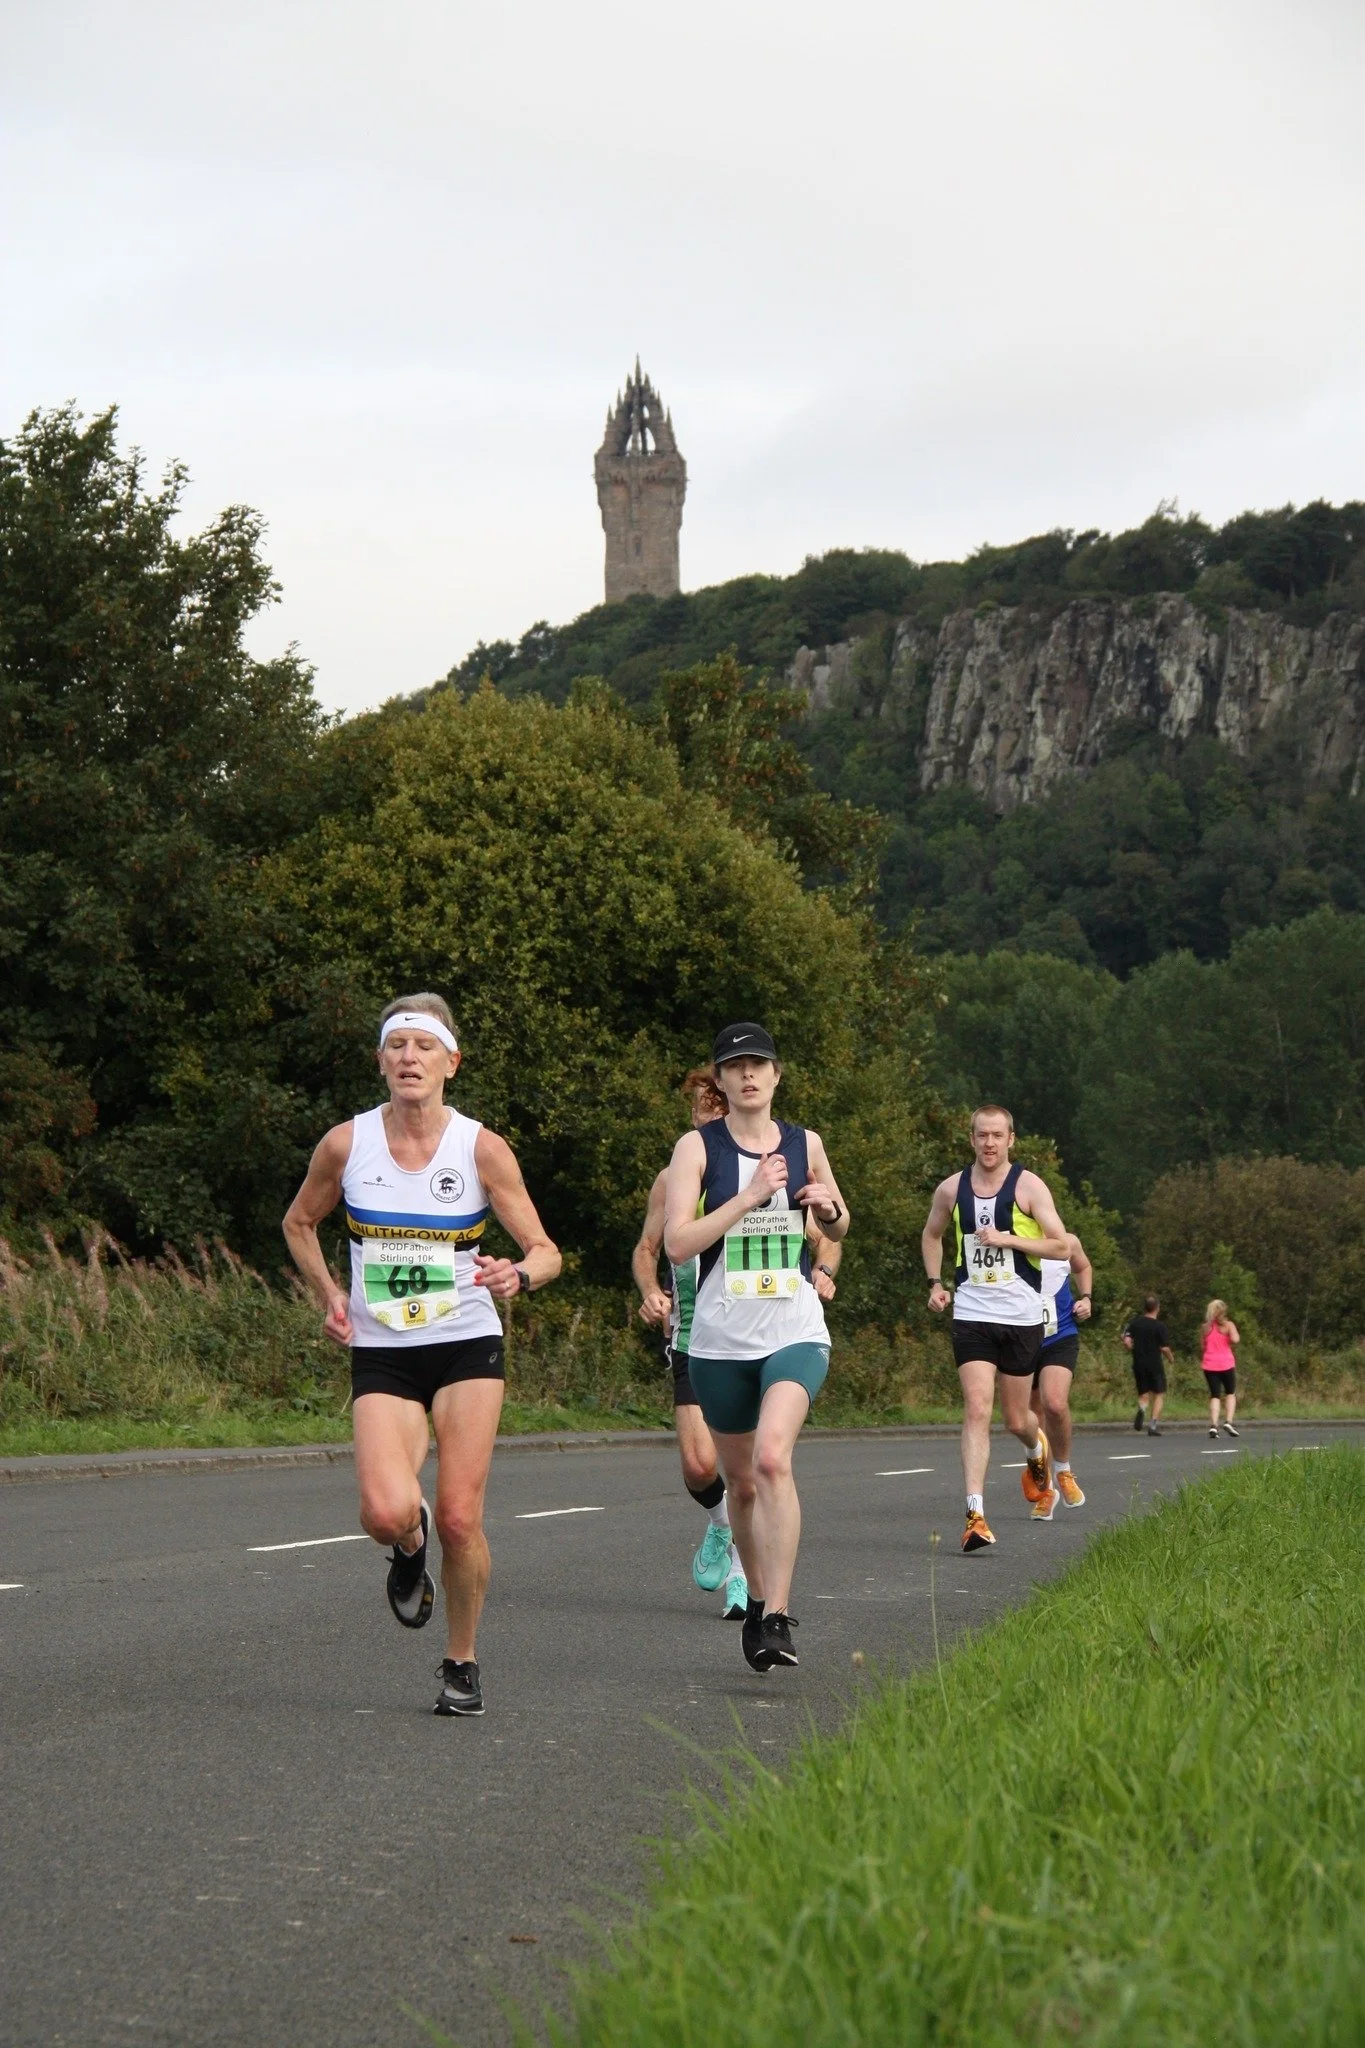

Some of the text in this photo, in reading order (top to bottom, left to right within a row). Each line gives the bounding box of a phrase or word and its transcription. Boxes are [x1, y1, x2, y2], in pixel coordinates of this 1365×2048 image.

[744, 1216, 788, 1224] PODFather
[455, 1228, 475, 1242] AC
[741, 1224, 789, 1235] Stirling 10K
[381, 1242, 434, 1252] PODFather
[743, 1235, 788, 1270] 111
[379, 1253, 435, 1264] Stirling 10K
[973, 1247, 1005, 1268] 464
[387, 1265, 430, 1299] 68
